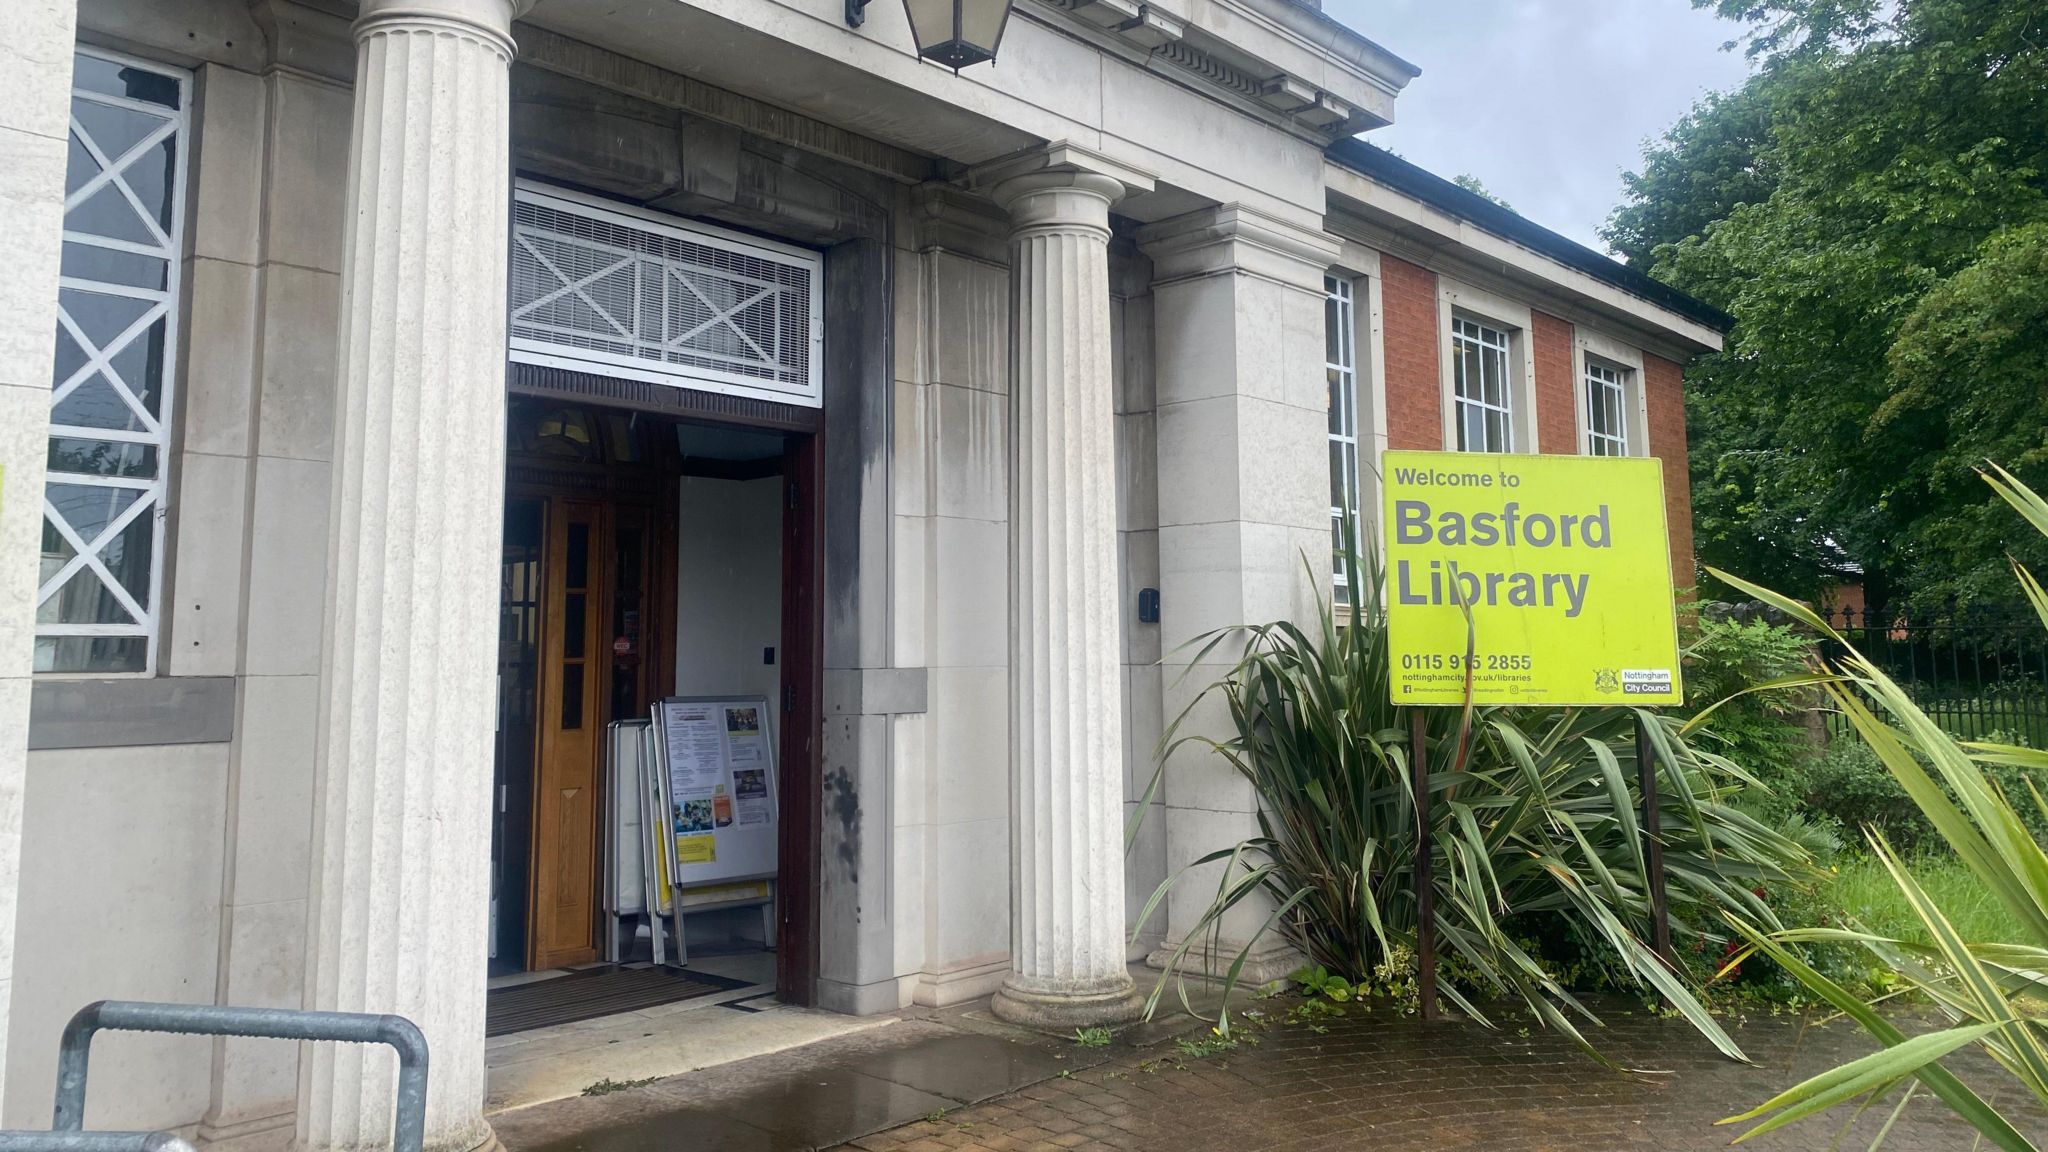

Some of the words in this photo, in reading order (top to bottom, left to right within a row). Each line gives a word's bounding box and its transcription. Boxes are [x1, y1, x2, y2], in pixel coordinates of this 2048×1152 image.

[1395, 468, 1493, 487] Welcome
[1499, 471, 1520, 487] to
[1395, 500, 1611, 548] Basford
[1397, 560, 1590, 617] Library
[1402, 654, 1442, 670] 0115
[1488, 655, 1531, 670] 2855
[1402, 673, 1532, 683] nottinghamcity.ov.uk/libraries
[1624, 672, 1668, 680] Nottingham
[1625, 684, 1640, 692] City
[1642, 684, 1670, 692] Council
